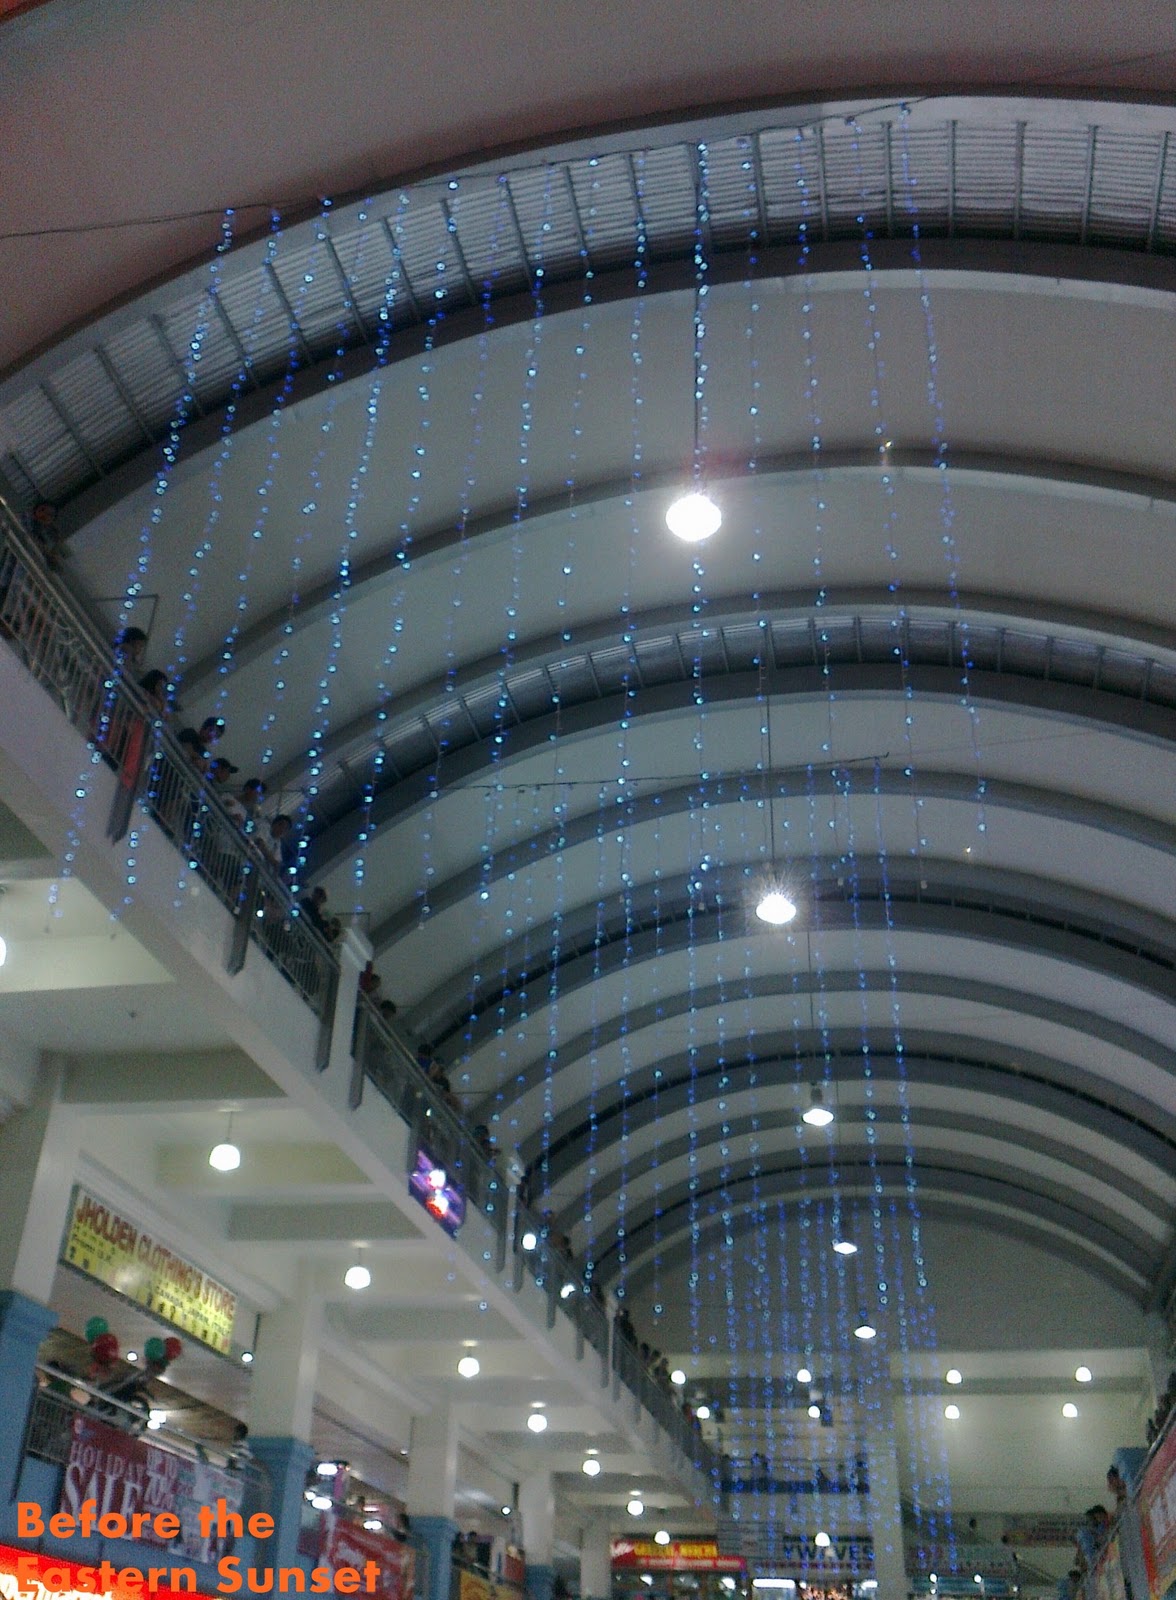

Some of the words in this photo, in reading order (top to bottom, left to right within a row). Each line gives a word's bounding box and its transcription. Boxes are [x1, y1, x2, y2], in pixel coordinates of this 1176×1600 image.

[202, 1278, 236, 1321] STORE
[69, 1441, 147, 1484] HOLIDAY
[59, 1461, 144, 1540] SALE
